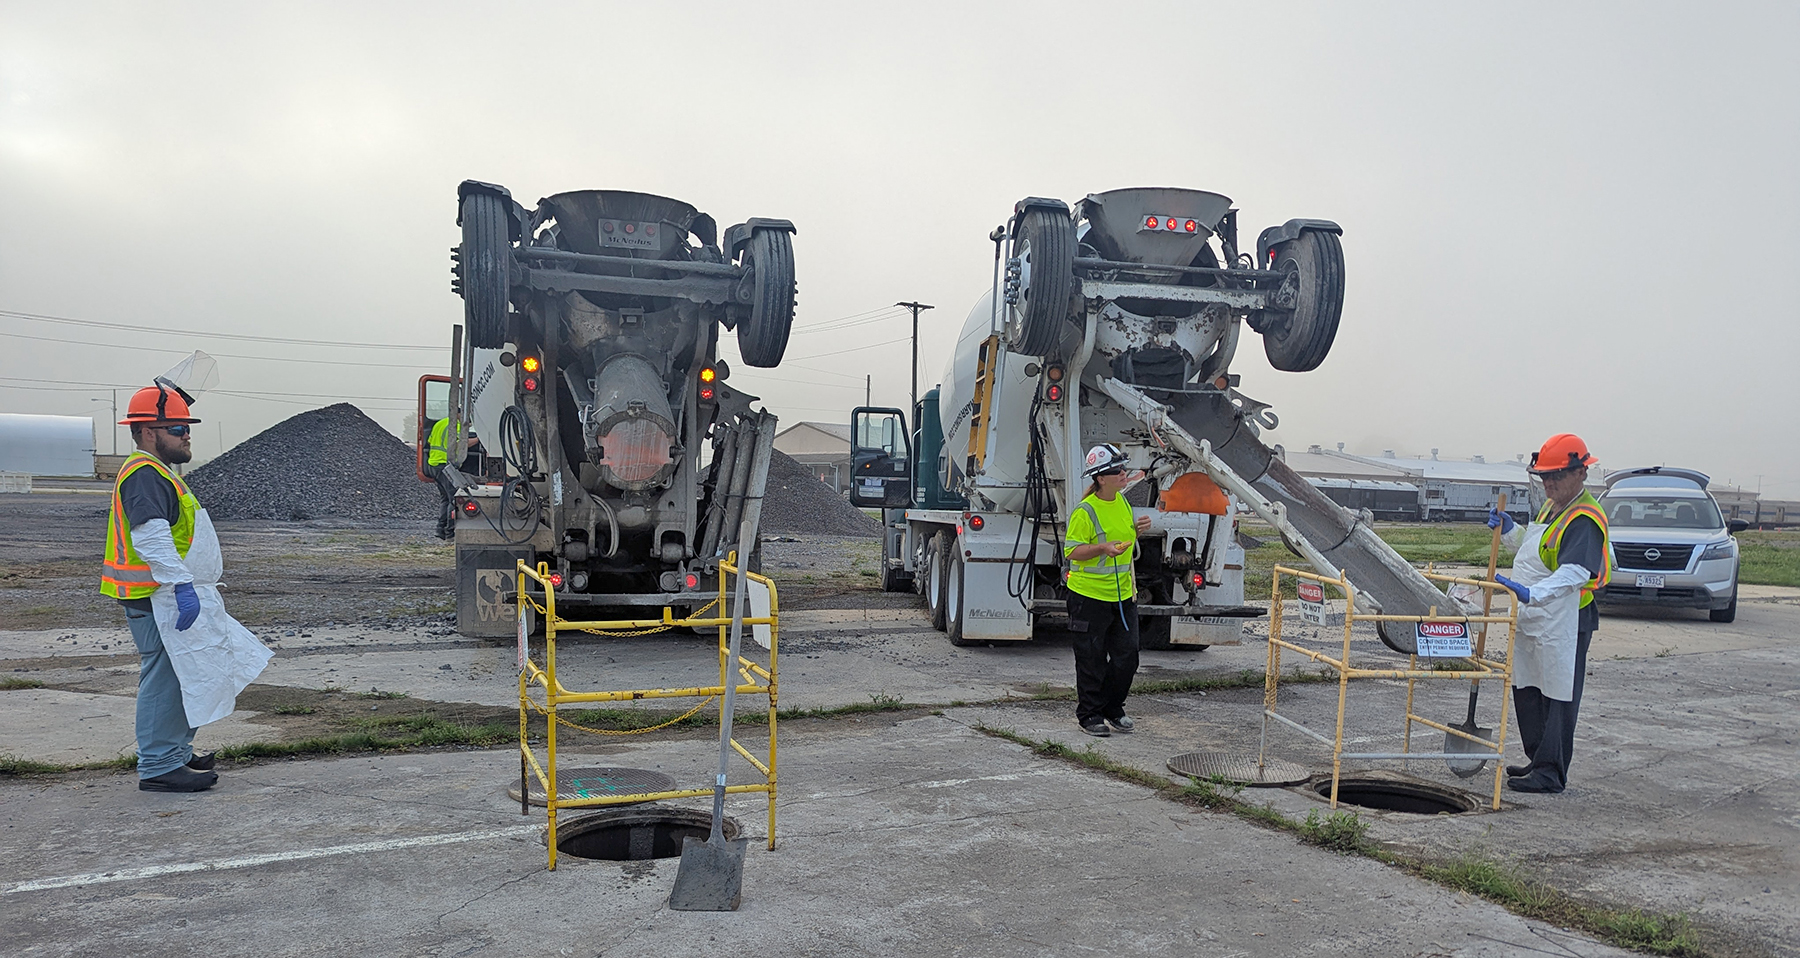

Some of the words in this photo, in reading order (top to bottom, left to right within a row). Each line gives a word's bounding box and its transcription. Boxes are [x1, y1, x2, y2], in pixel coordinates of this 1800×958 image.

[1299, 585, 1321, 598] DANGER
[1302, 602, 1308, 610] DO
[1309, 605, 1321, 613] NOT
[1304, 612, 1320, 623] ENTER
[1422, 624, 1461, 634] DANGER
